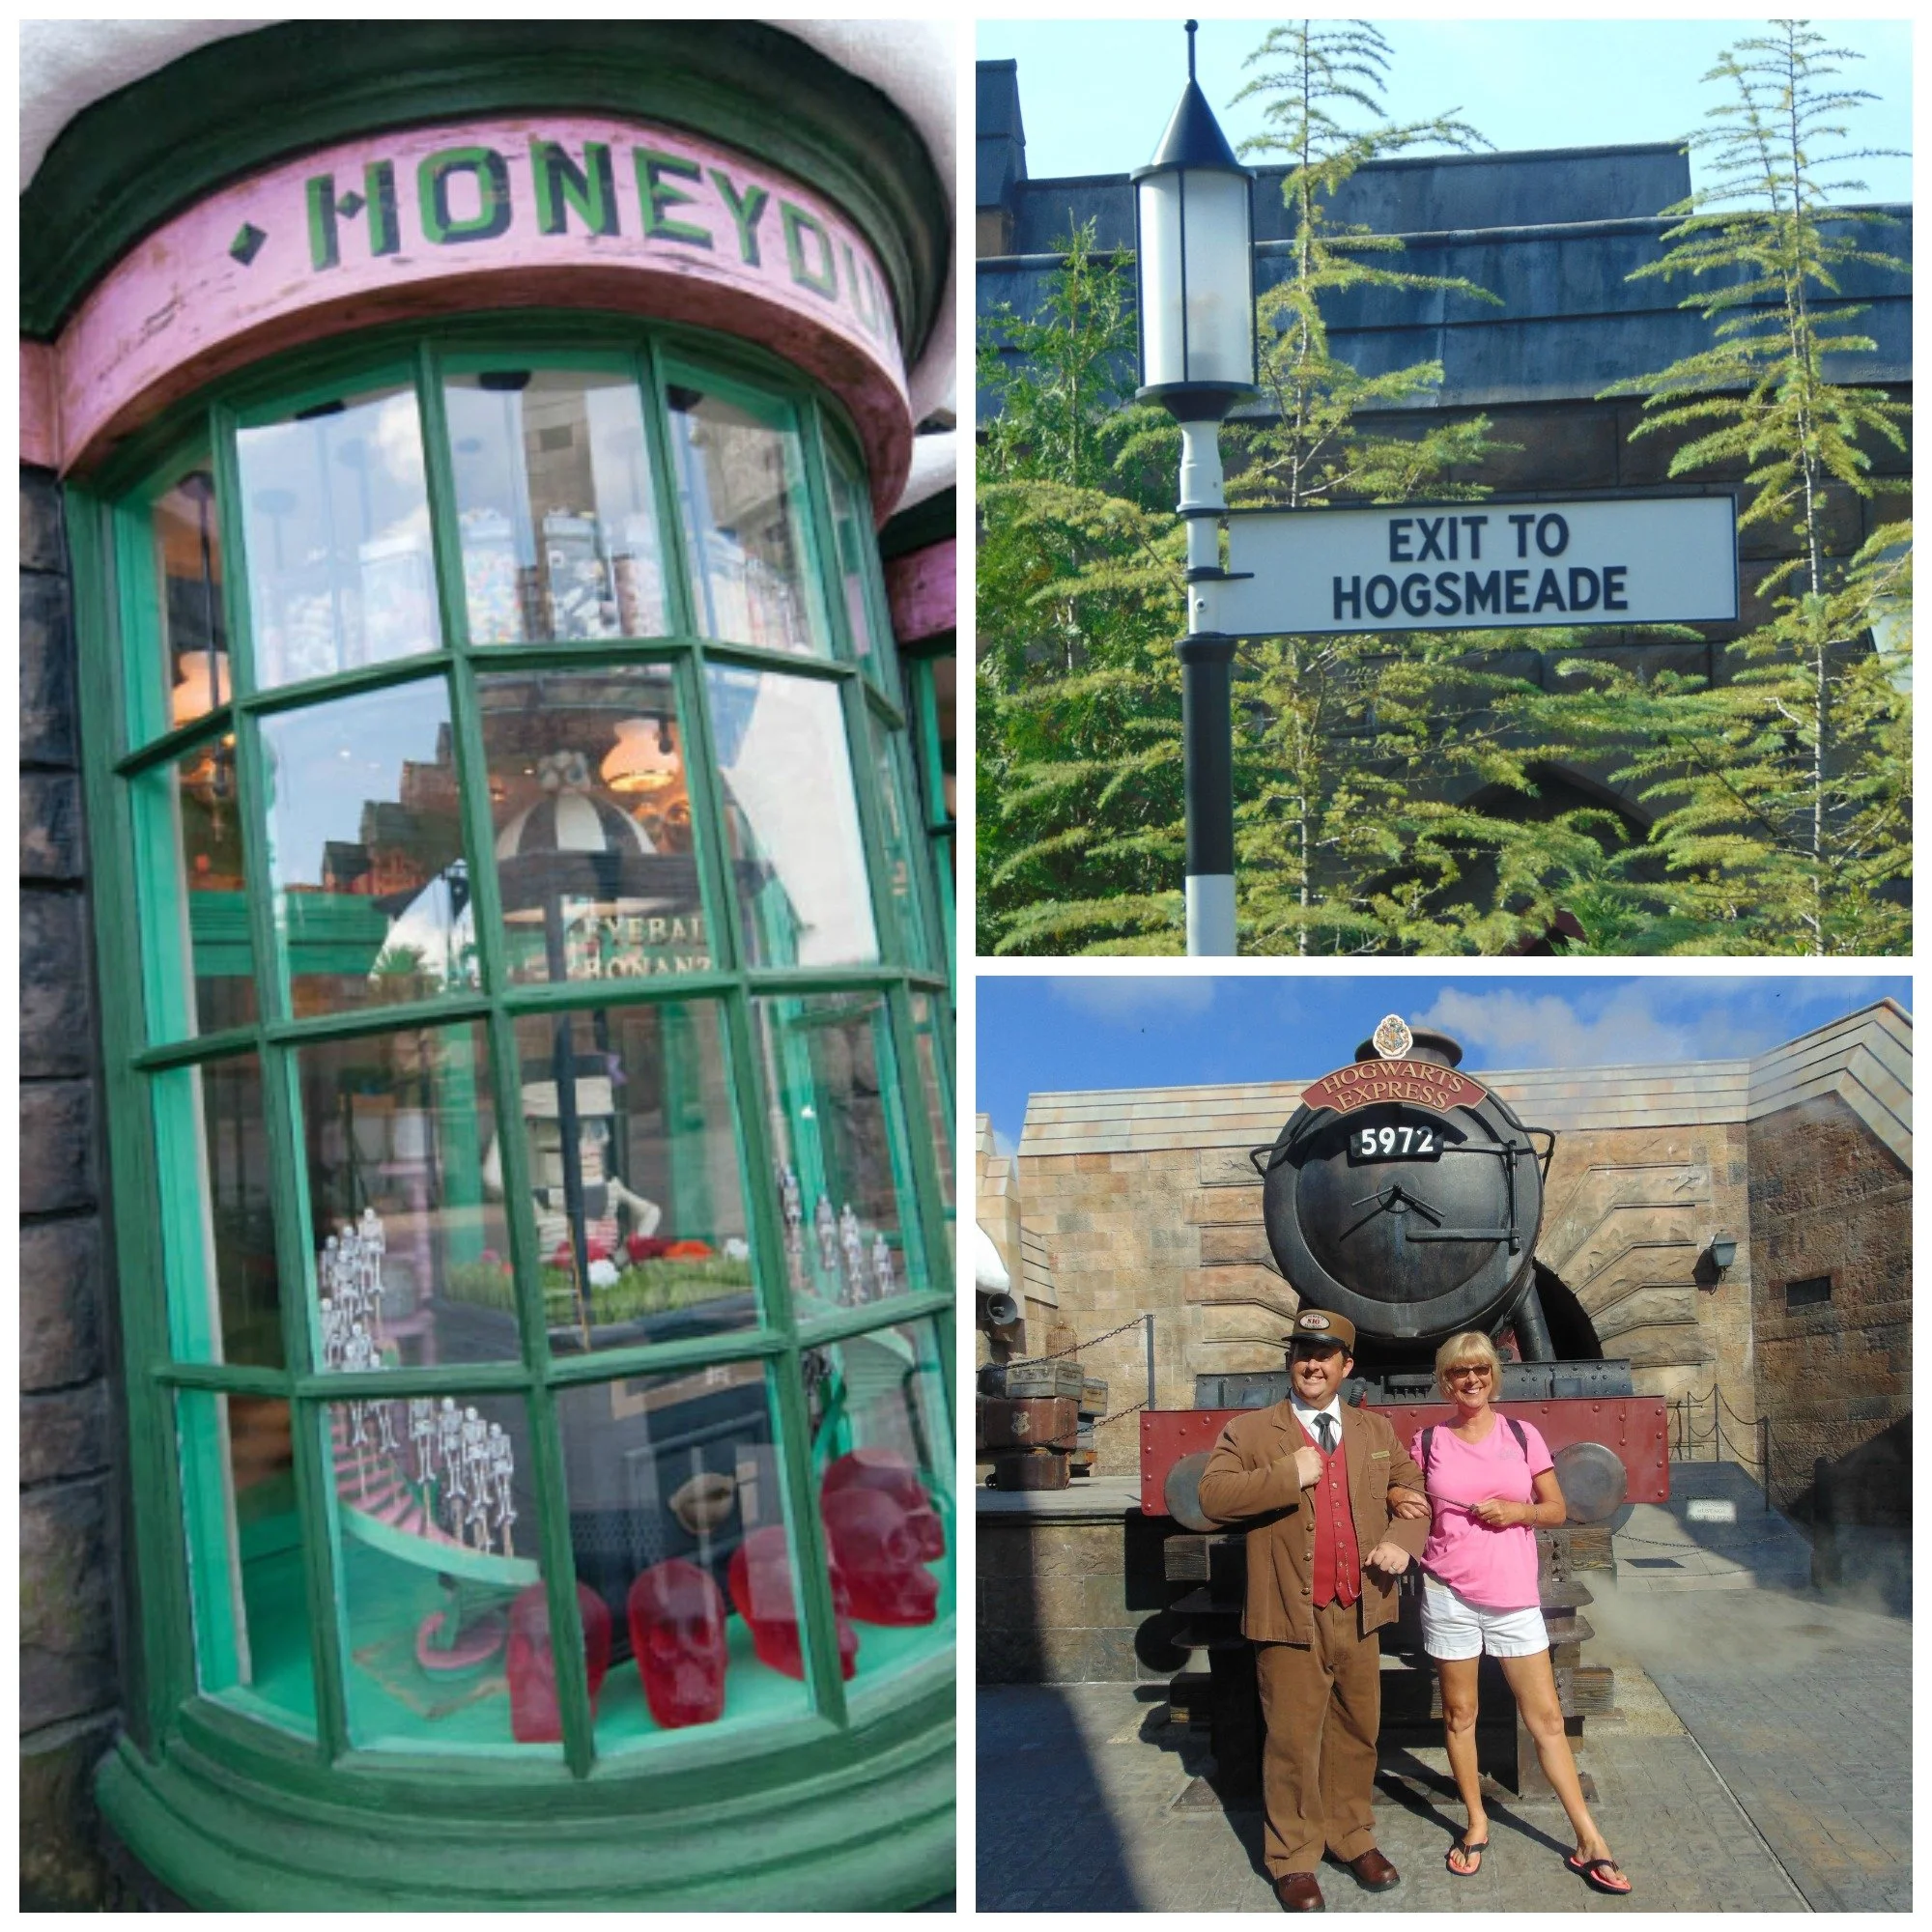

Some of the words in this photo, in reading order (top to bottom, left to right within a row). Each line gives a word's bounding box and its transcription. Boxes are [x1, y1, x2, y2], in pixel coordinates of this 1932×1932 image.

[305, 140, 894, 333] HONEYDU
[1388, 515, 1489, 563] EXIT
[1508, 512, 1570, 558] TO
[1332, 565, 1629, 620] HOGSMEADE
[583, 917, 708, 946] EYEBAL
[1320, 1063, 1465, 1094] HOGWARTS
[1334, 1081, 1450, 1110] EXPRESS
[1360, 1125, 1435, 1155] 5972
